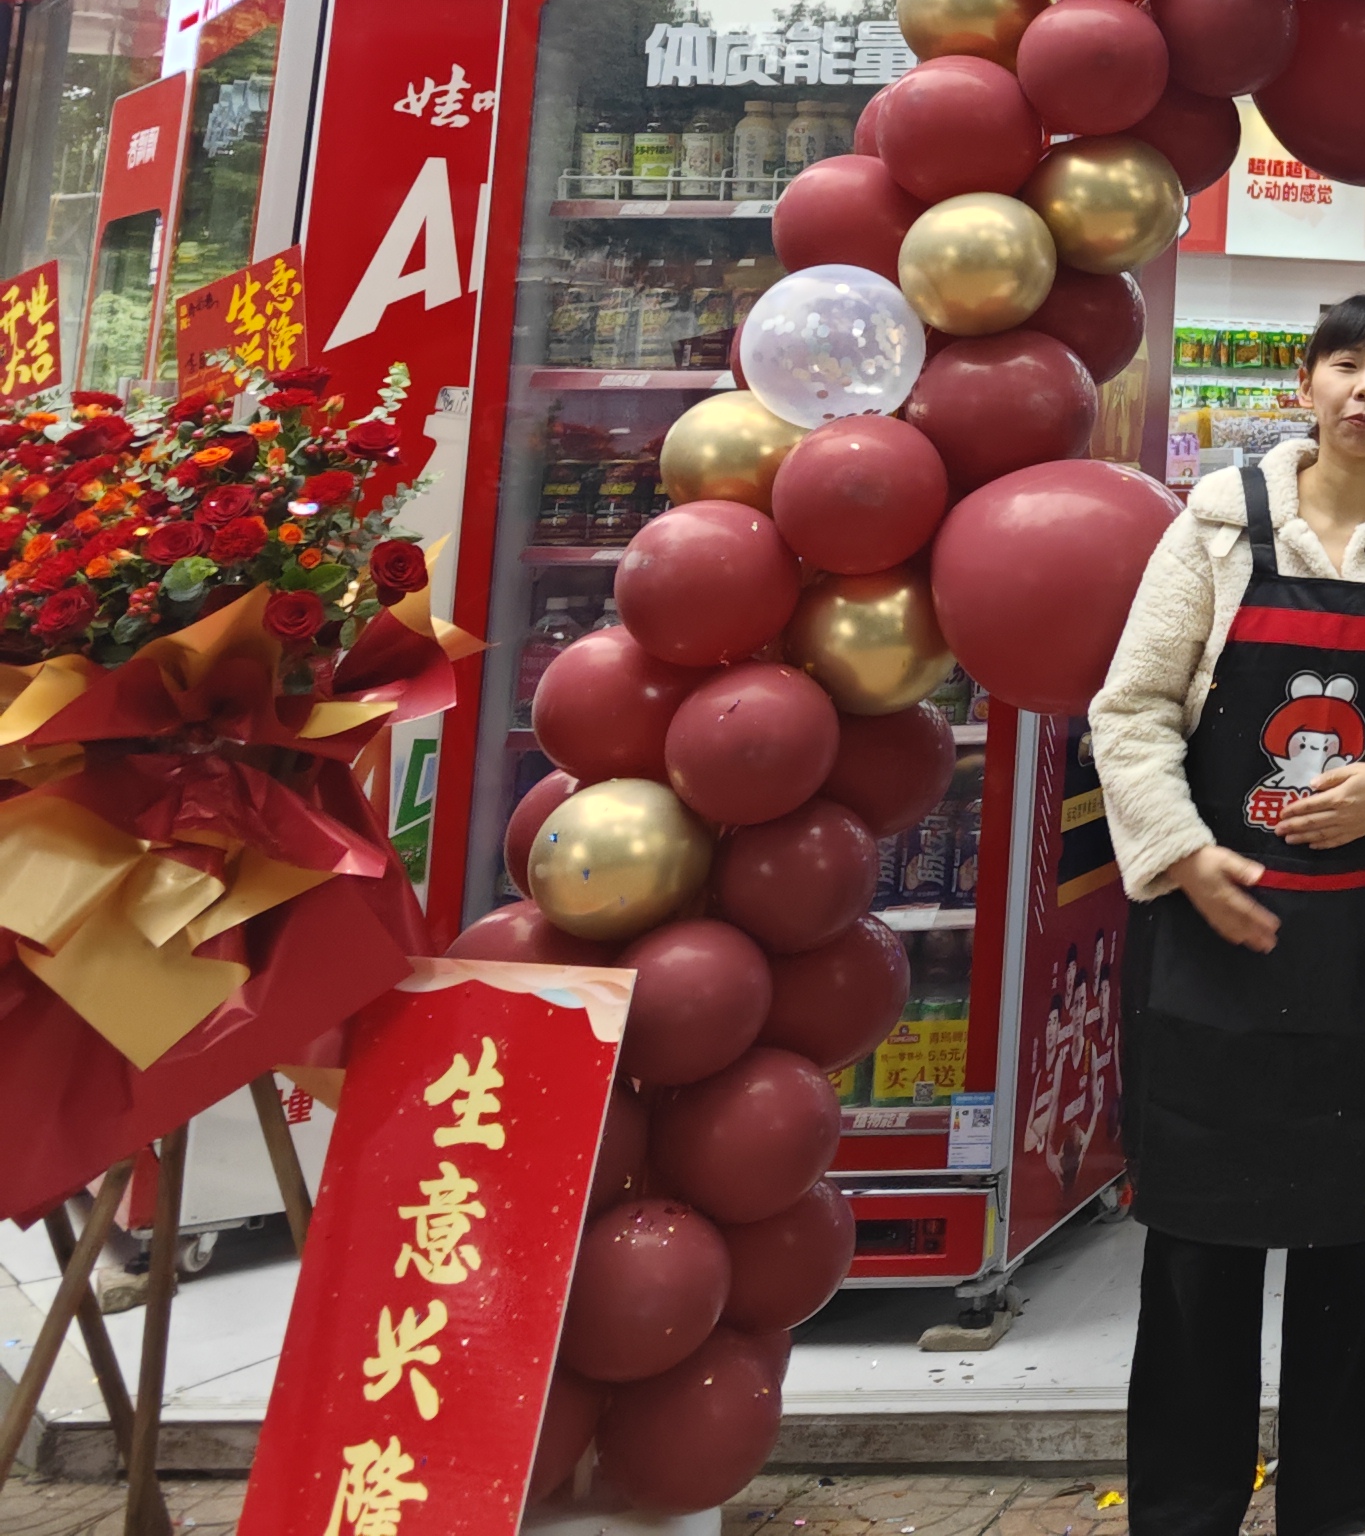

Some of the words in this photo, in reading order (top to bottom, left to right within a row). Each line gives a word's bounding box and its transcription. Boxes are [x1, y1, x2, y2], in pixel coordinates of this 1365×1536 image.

[645, 21, 918, 87] 体质能量
[1247, 157, 1335, 180] 超值超
[1247, 180, 1333, 204] 心动的感觉
[323, 156, 488, 352] A
[885, 1065, 966, 1090] 买4送
[323, 1037, 506, 1536] 生意兴隆
